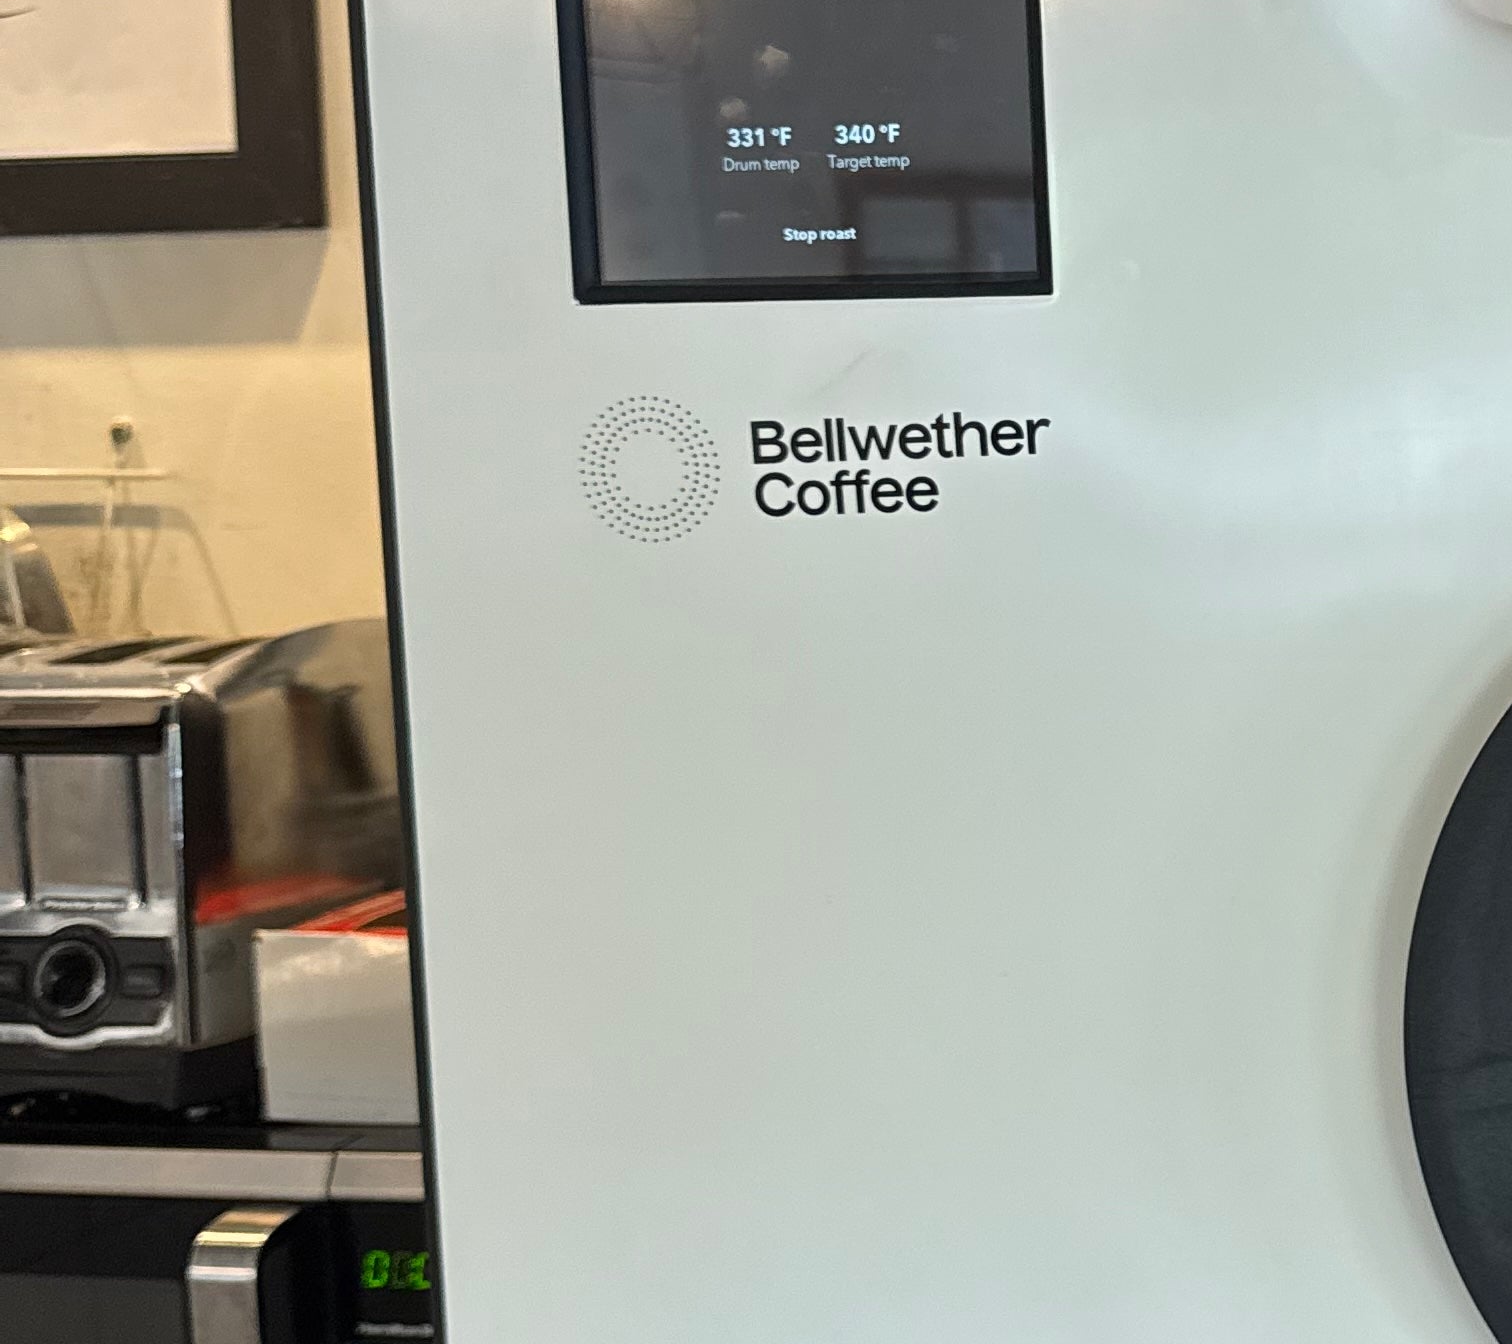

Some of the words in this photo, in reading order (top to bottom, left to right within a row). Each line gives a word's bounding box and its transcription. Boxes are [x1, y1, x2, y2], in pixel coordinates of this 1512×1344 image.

[726, 127, 765, 148] 331
[834, 124, 876, 145] 340
[722, 157, 762, 173] Drum
[763, 157, 800, 174] temp
[826, 153, 873, 173] Target
[874, 155, 911, 172] temp
[782, 227, 818, 244] Stop
[819, 226, 857, 242] roast
[749, 410, 1051, 465] Bellwether
[754, 469, 939, 517] Coffee
